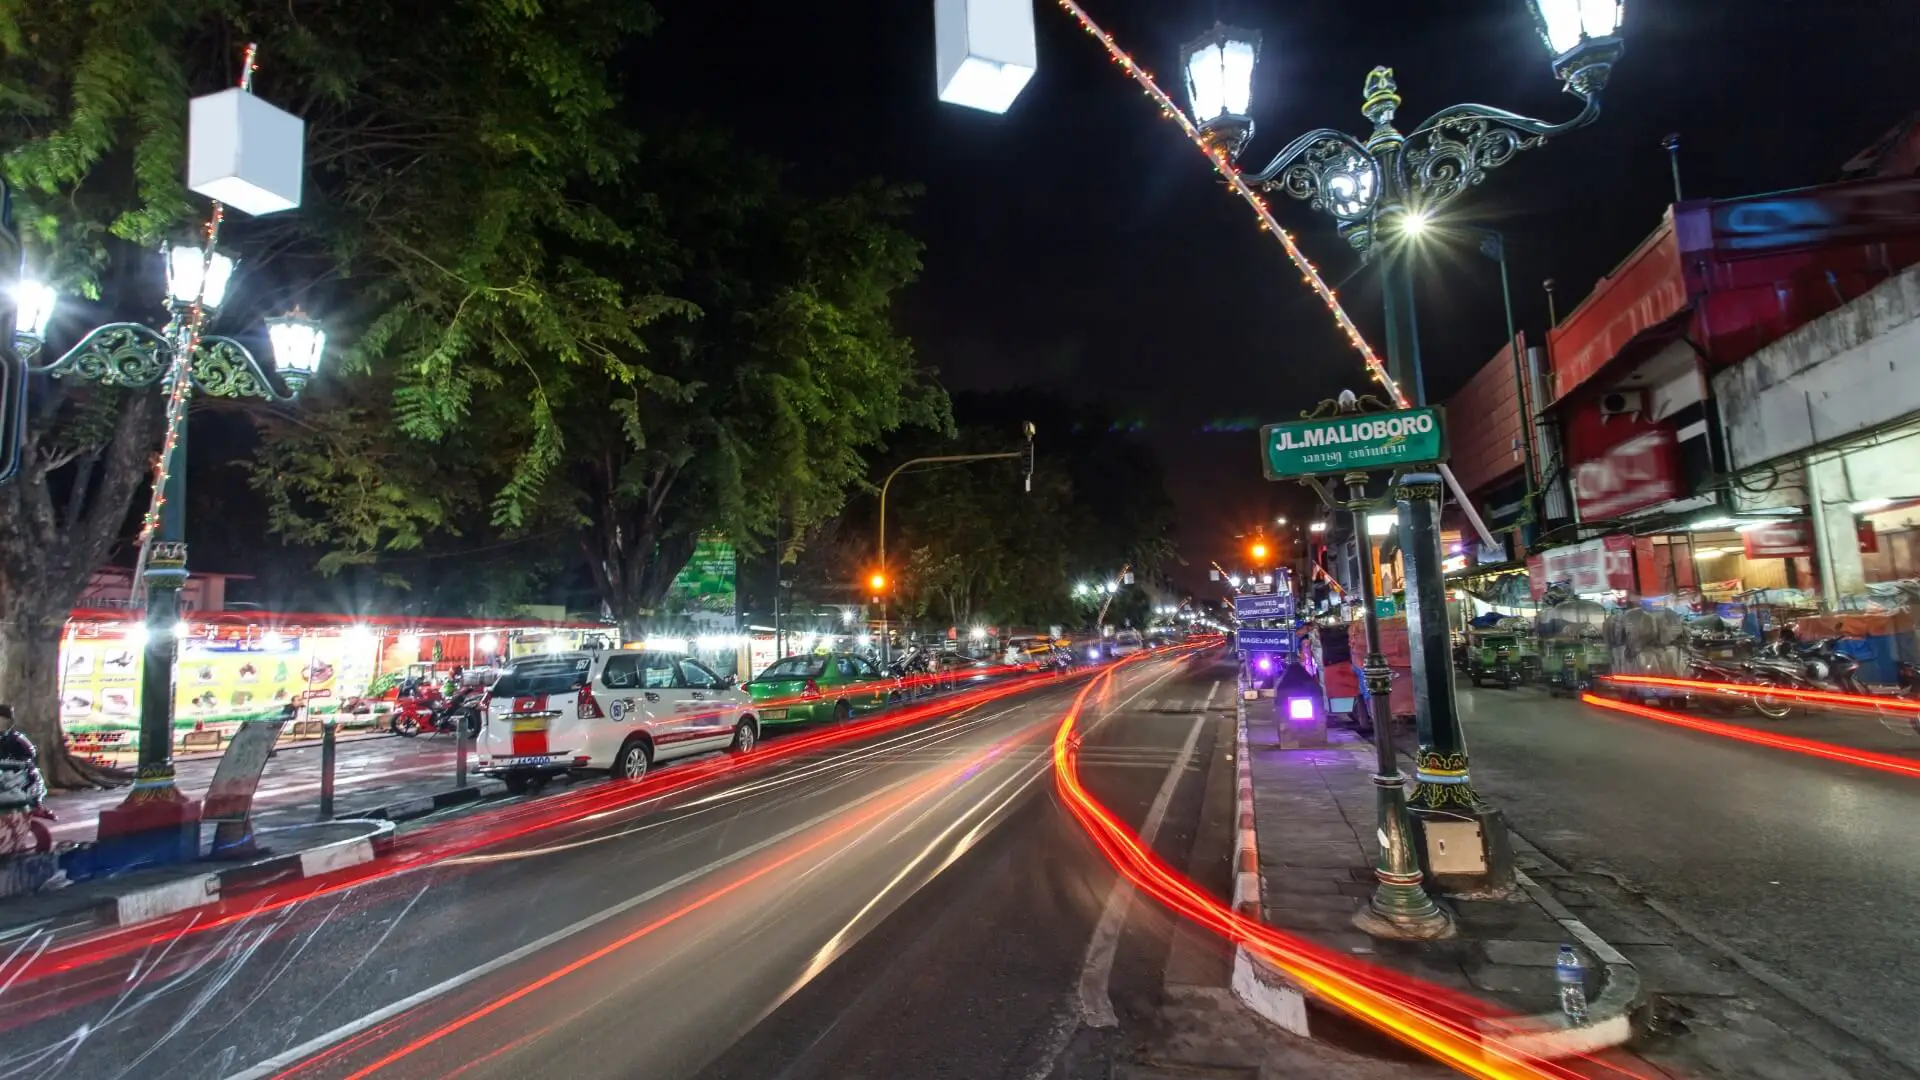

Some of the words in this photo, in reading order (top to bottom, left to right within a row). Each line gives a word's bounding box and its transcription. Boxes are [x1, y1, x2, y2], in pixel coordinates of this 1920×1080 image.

[1275, 414, 1433, 451] JL.MALIOBORO
[1238, 608, 1279, 616] PURWOREJO
[1240, 637, 1279, 645] MAGELANG
[576, 659, 589, 670] 157
